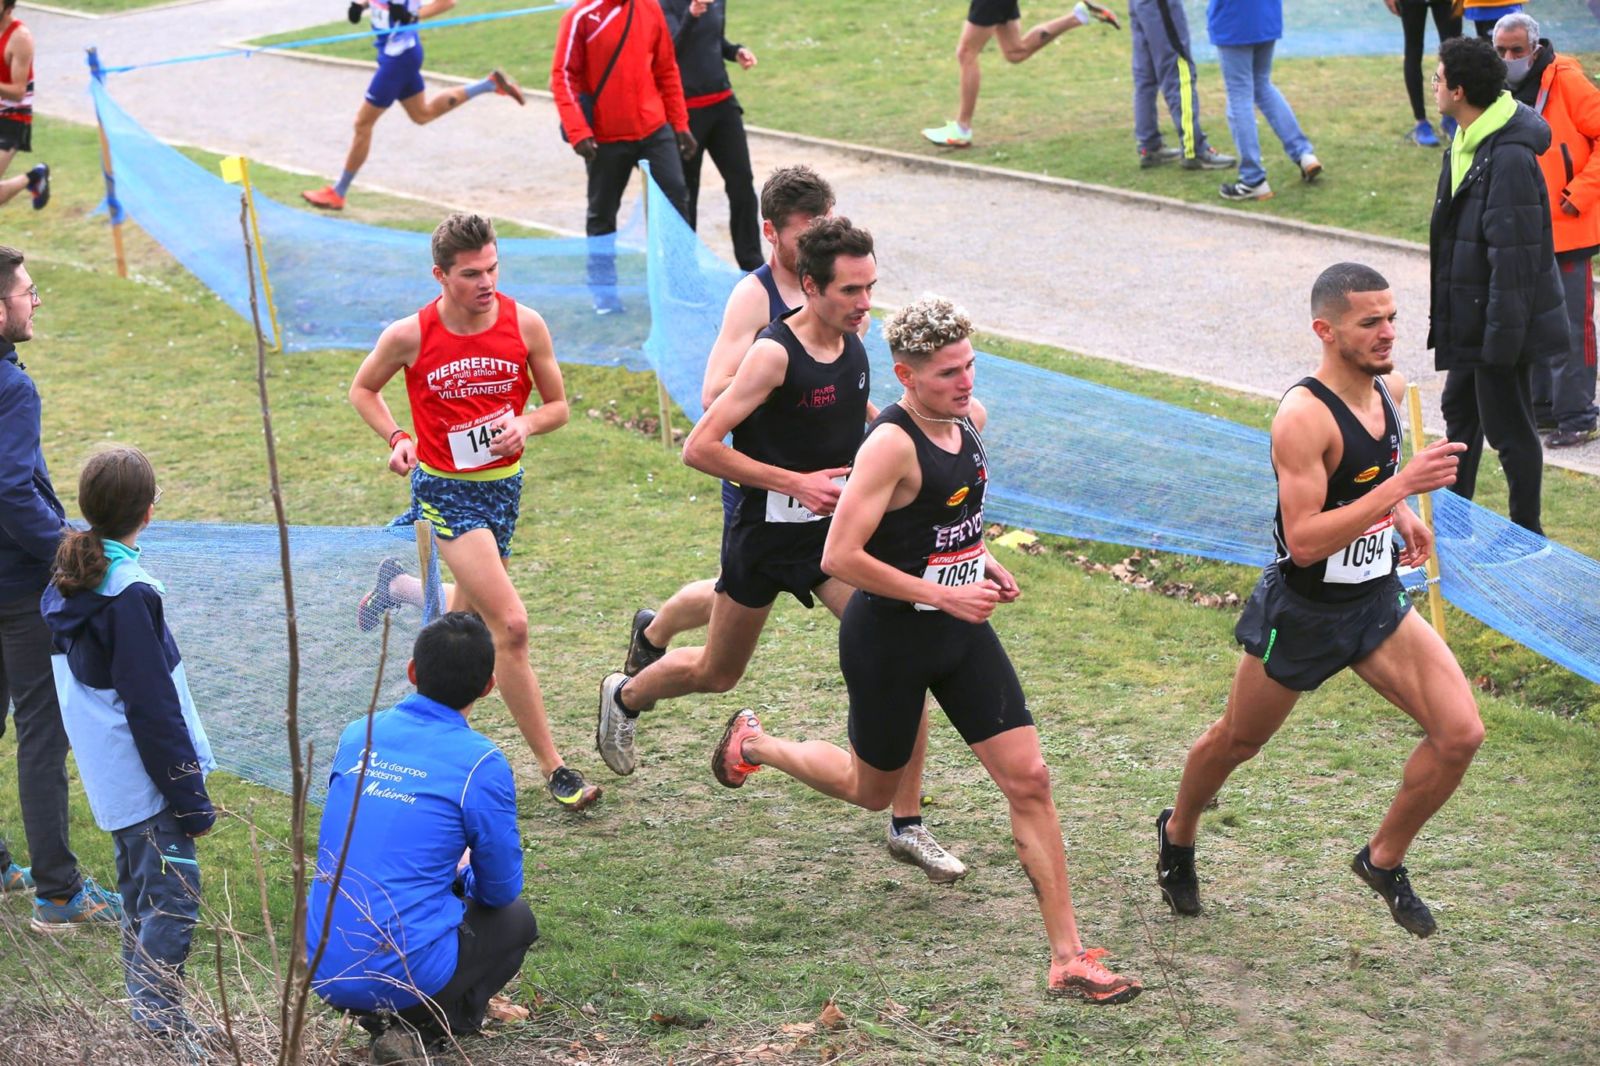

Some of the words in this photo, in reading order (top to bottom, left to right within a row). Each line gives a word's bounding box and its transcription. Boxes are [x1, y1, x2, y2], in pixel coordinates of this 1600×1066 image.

[427, 357, 519, 385] PIERREFITTE
[452, 369, 471, 380] multi
[473, 367, 497, 377] athlon
[438, 382, 513, 399] VILLETANEUSE
[814, 384, 836, 394] PARIS
[813, 393, 837, 404] RMA
[1342, 531, 1385, 567] 1094
[937, 558, 979, 587] 1095
